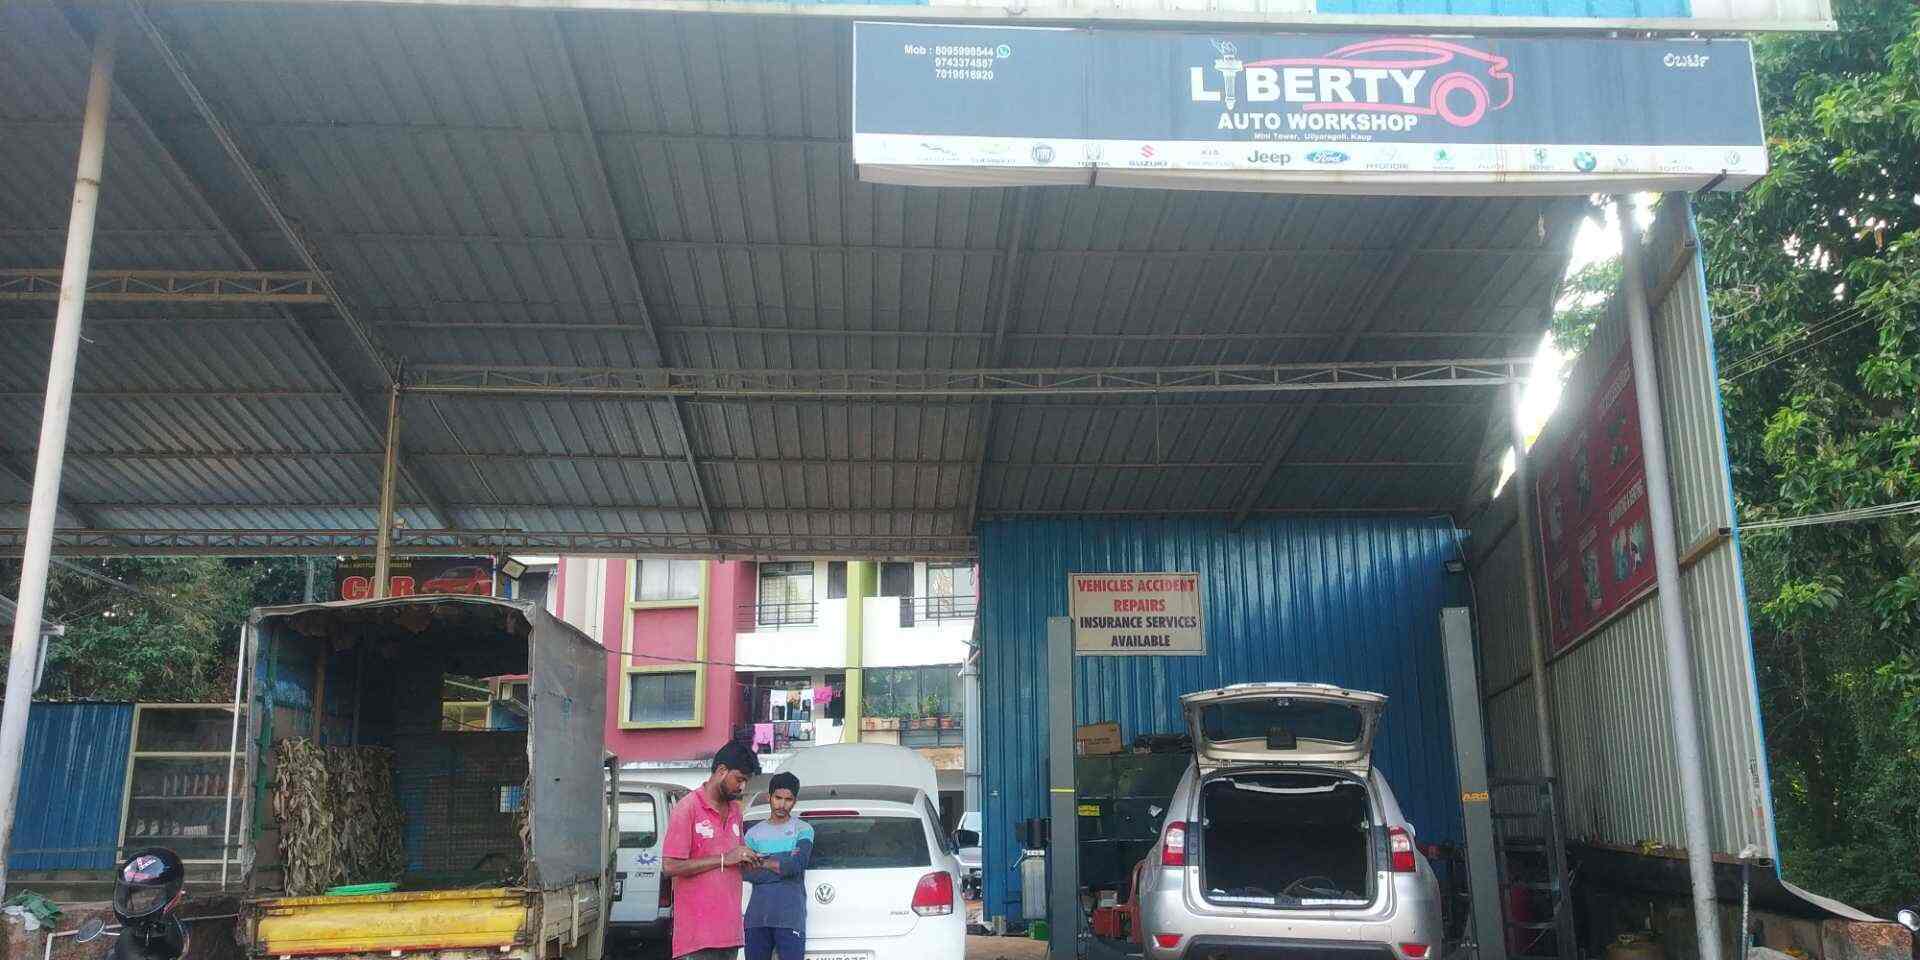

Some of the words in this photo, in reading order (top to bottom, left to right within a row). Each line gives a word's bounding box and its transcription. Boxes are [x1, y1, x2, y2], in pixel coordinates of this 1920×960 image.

[904, 44, 927, 55] Mob
[1190, 58, 1426, 104] LIBERTY
[1217, 113, 1281, 130] AUTO
[1287, 113, 1418, 131] WORKSHOP
[1247, 150, 1291, 166] Jeep
[1078, 579, 1133, 592] VEHICLES
[1138, 579, 1195, 592] ACCIDENT
[1114, 599, 1166, 612] REPAIRS
[1080, 615, 1143, 628] INSURANCE
[1146, 615, 1197, 628] SERVICES
[1112, 635, 1170, 647] AVAILABLE
